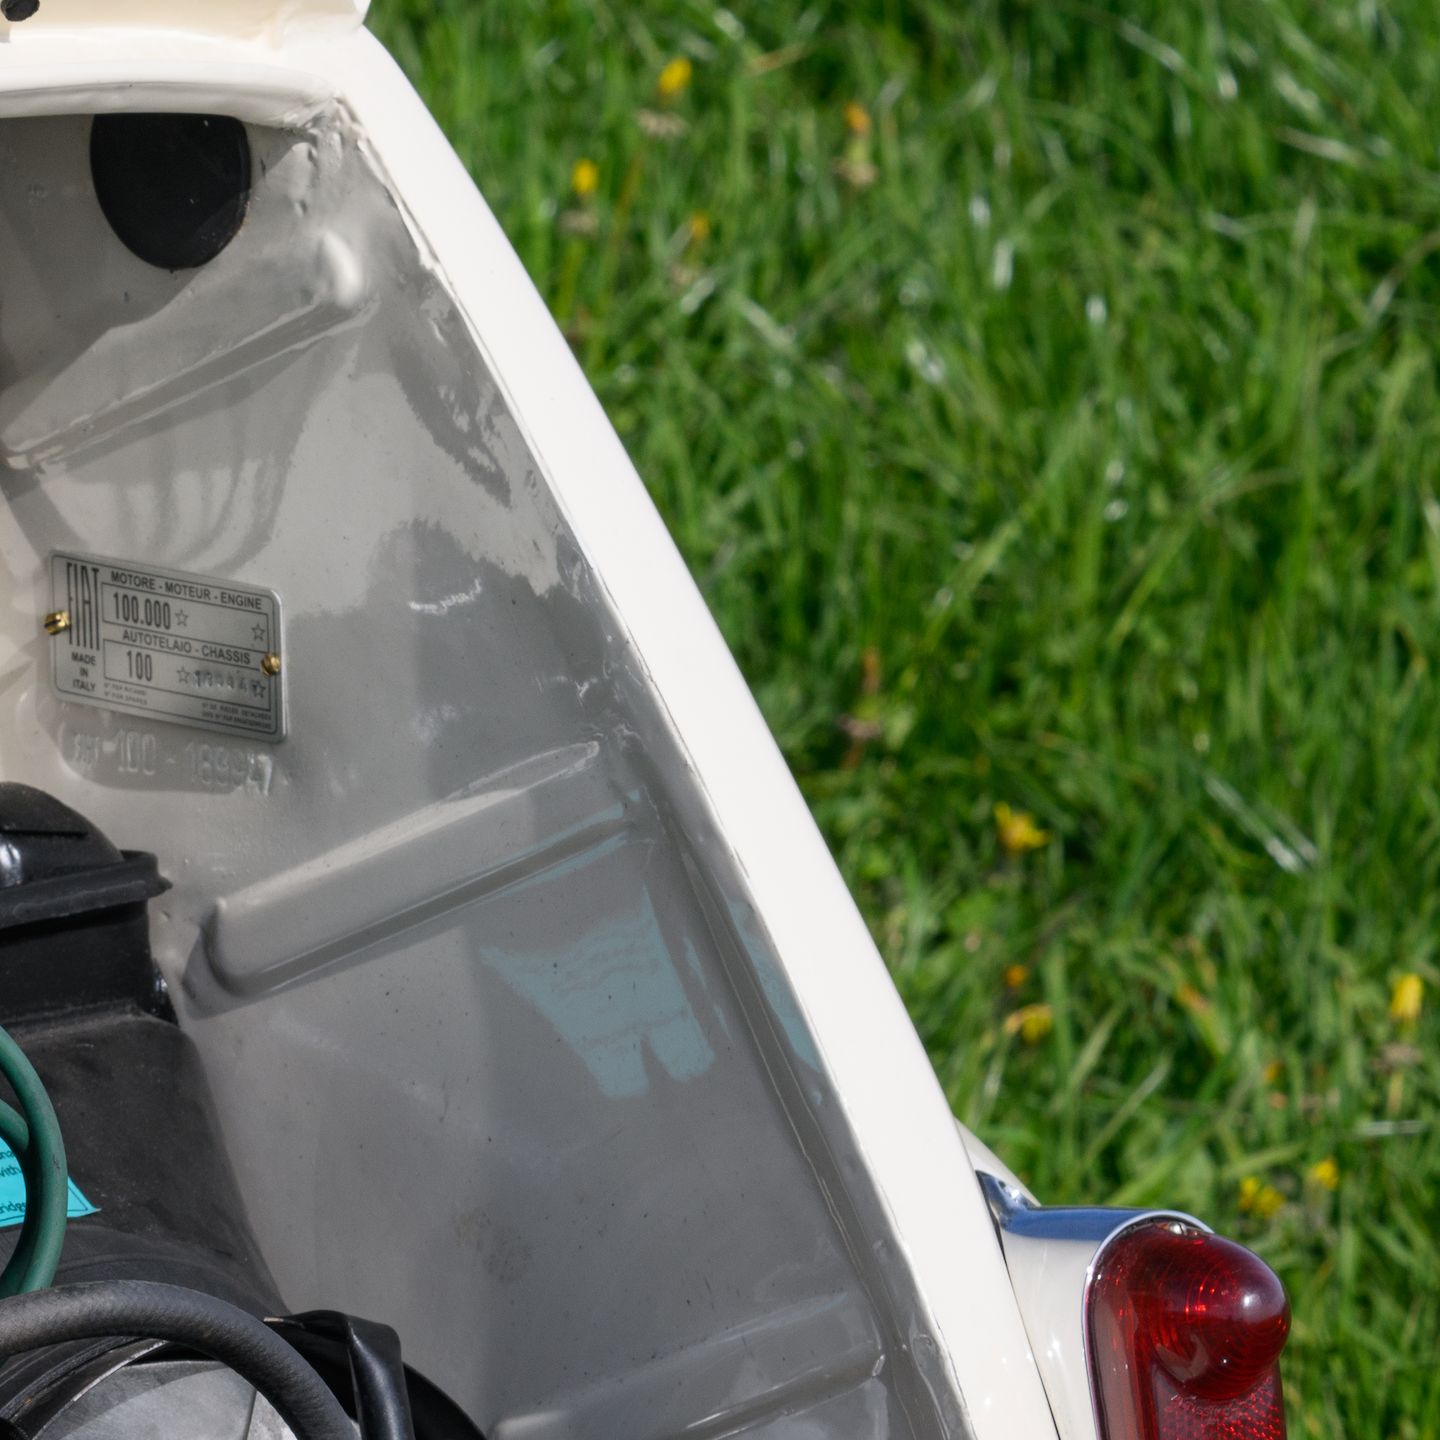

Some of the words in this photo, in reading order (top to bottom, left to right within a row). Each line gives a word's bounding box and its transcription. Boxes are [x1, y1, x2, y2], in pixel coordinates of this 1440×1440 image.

[66, 561, 101, 651] FIAT
[110, 570, 155, 591] MOTORE
[164, 581, 211, 601] MOTEUR
[220, 591, 262, 610] ENGINE
[113, 591, 171, 630] 100.000
[71, 651, 96, 666] MADE
[122, 629, 192, 654] AUTOTELAIO
[201, 644, 251, 665] CHASSIS
[79, 666, 89, 679] IN
[126, 651, 153, 682] 100
[72, 679, 96, 693] ITALY
